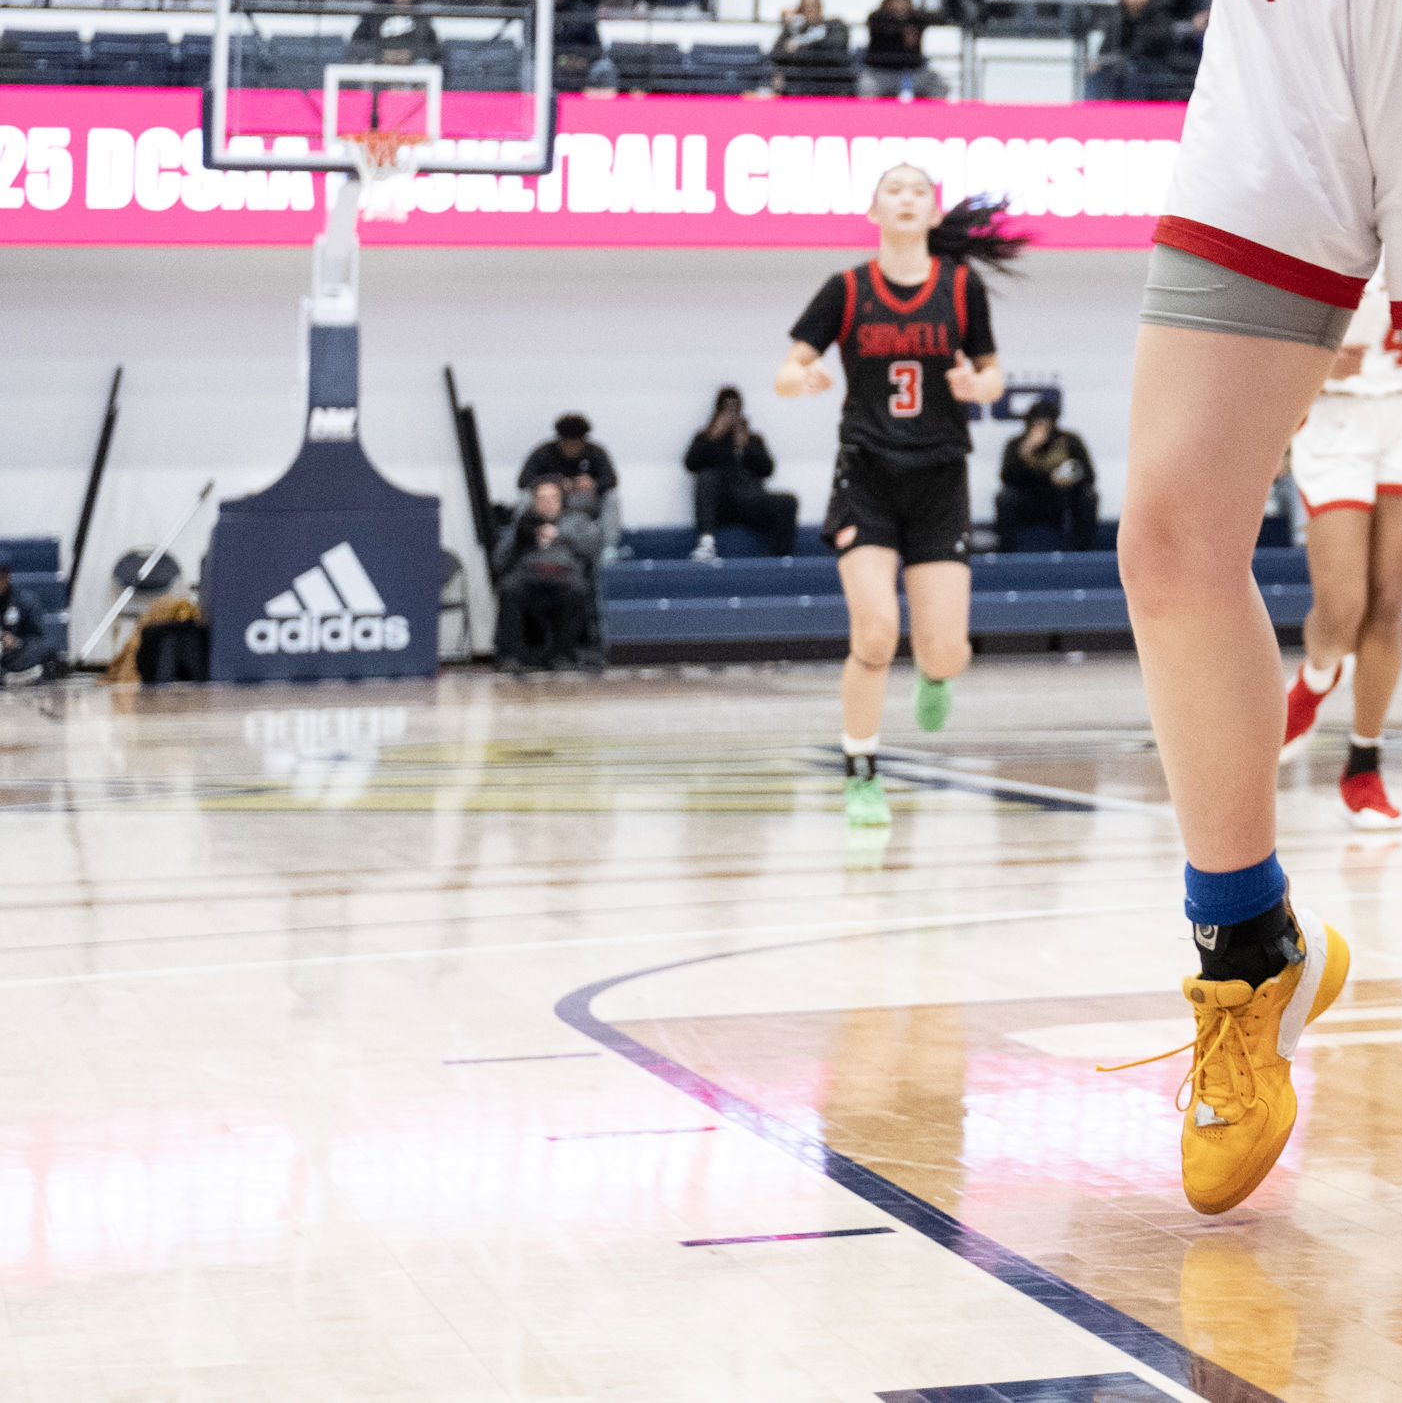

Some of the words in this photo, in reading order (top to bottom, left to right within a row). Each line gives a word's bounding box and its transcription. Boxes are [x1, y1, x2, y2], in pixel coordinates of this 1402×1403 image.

[325, 133, 716, 215] BSKETBALL
[888, 359, 924, 419] 3
[245, 609, 411, 655] adidas
